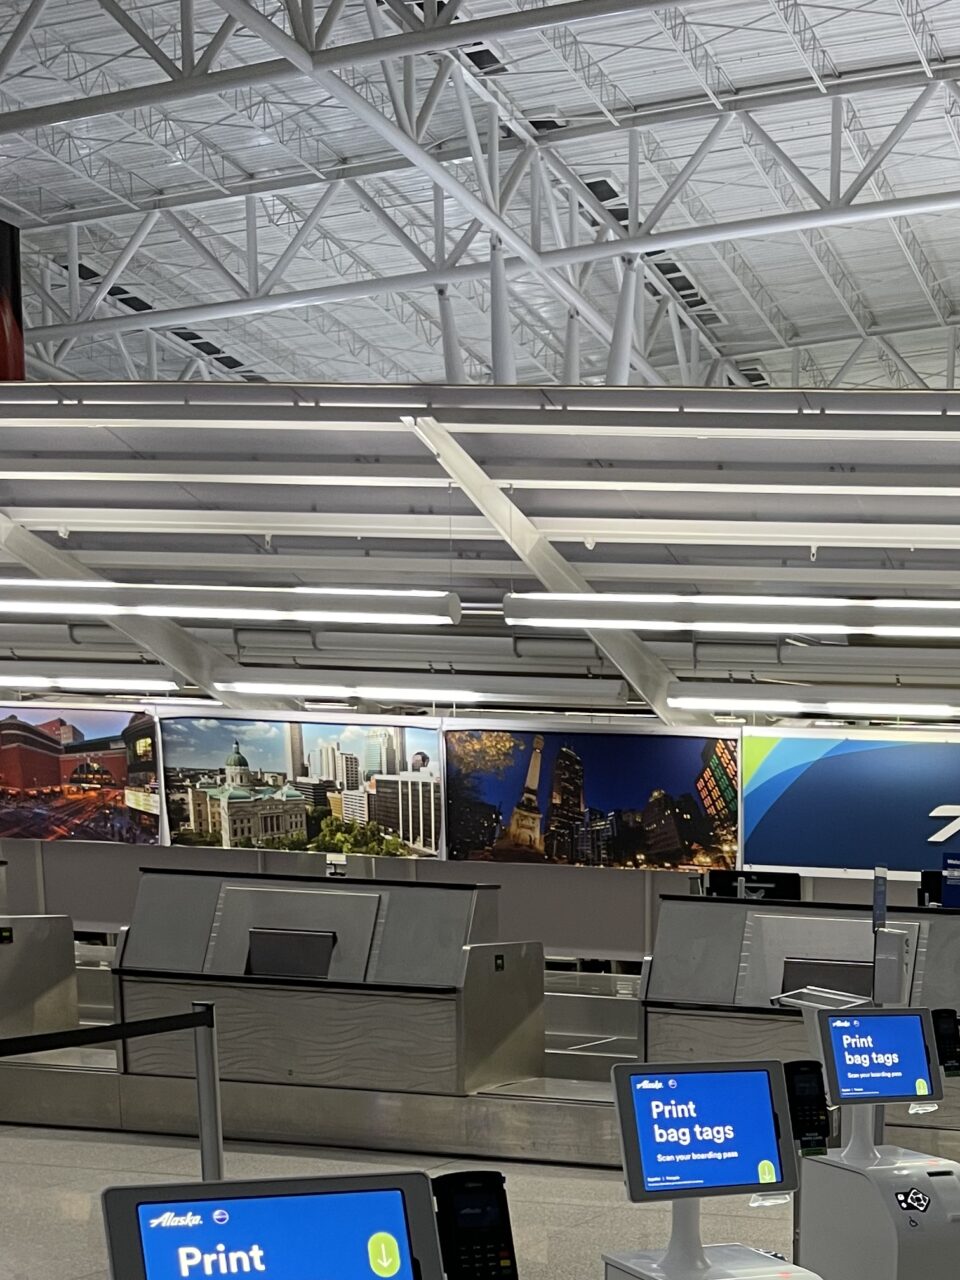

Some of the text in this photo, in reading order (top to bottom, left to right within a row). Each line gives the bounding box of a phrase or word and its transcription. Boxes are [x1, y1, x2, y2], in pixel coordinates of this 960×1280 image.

[843, 1034, 874, 1049] Print
[845, 1051, 899, 1067] bag tags
[650, 1099, 697, 1119] Print
[654, 1123, 735, 1146] bag tags
[656, 1149, 739, 1164] Scan your boarding pass
[177, 1243, 266, 1277] Print
